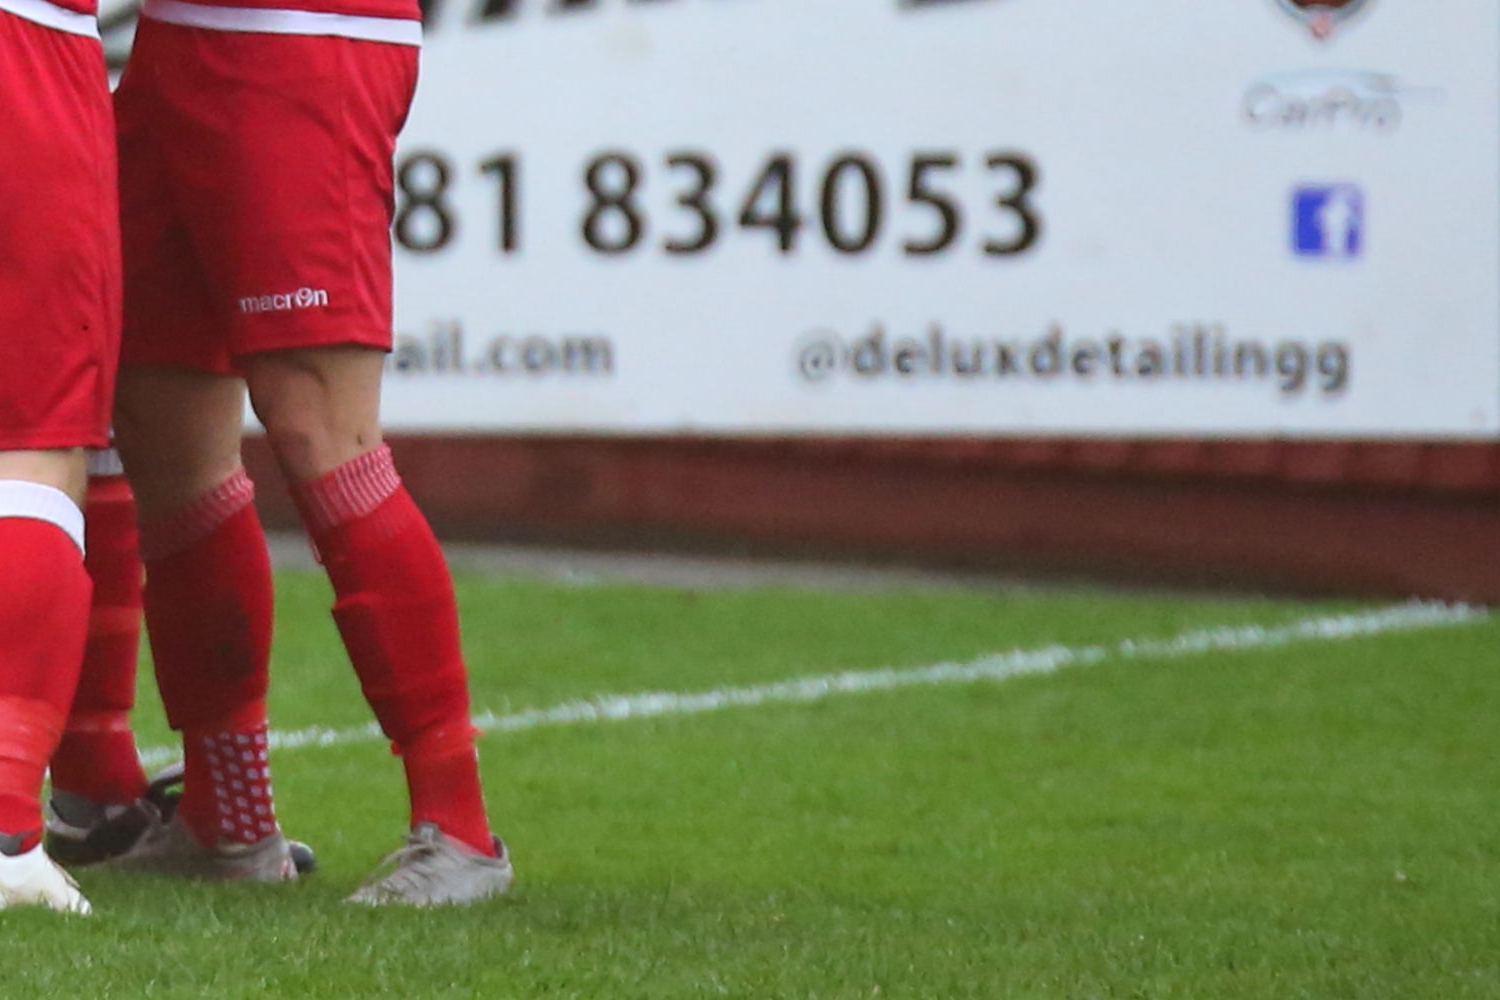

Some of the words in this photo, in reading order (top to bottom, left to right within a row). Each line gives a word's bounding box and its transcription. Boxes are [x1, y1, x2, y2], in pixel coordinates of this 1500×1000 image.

[580, 150, 1044, 256] 834053
[387, 317, 617, 378] ail.com
[794, 319, 1350, 395] @deluxdetailingg
